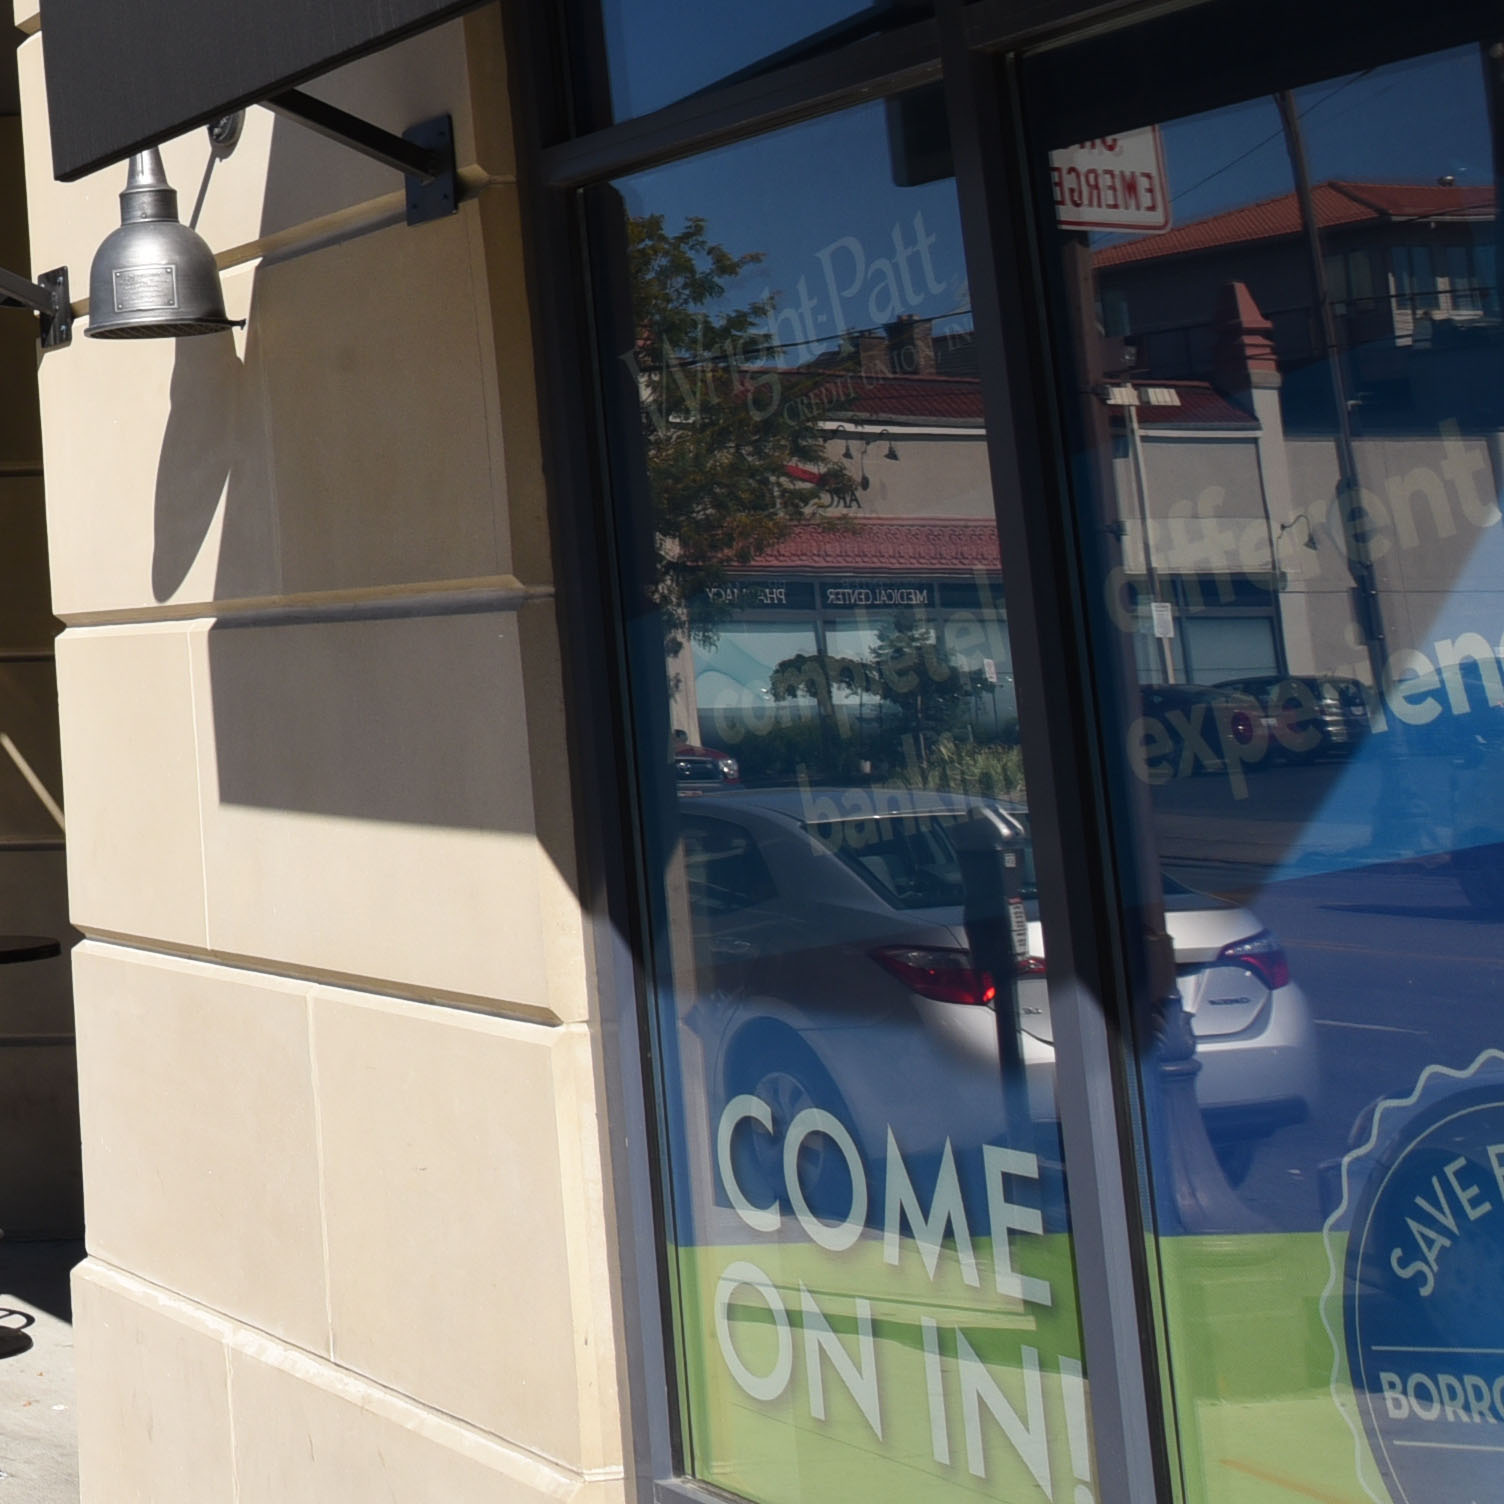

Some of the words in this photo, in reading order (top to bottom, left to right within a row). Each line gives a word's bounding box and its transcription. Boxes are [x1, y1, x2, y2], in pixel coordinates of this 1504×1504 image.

[618, 208, 950, 441] Wright-Patt
[1126, 626, 1504, 802] experien
[717, 1094, 1052, 1307] COME
[1390, 1156, 1492, 1297] SAVE
[714, 1261, 883, 1444] ON
